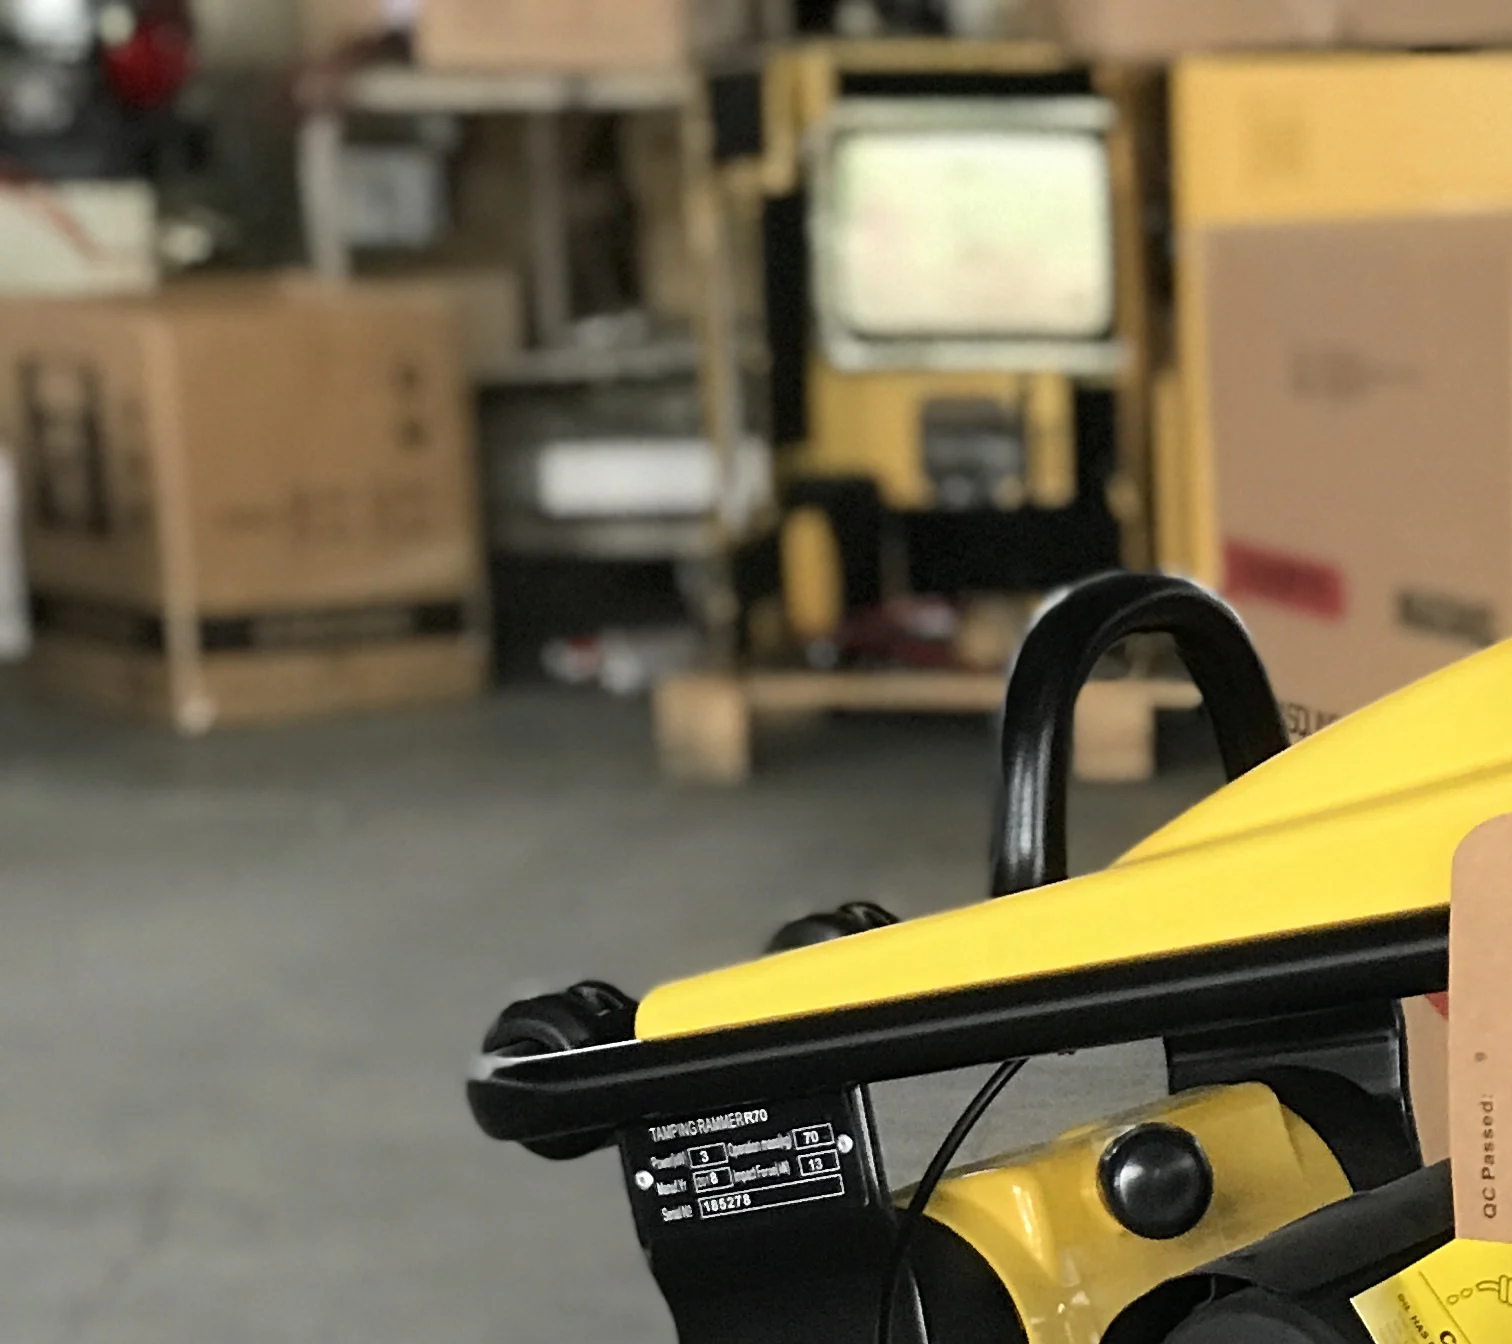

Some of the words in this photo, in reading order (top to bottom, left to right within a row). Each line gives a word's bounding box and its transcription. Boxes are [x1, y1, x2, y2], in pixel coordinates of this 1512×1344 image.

[700, 1150, 709, 1163] 3
[802, 1130, 819, 1145] 70
[1480, 1093, 1496, 1181] Passed:
[808, 1157, 823, 1171] 13
[1482, 1186, 1498, 1220] QC
